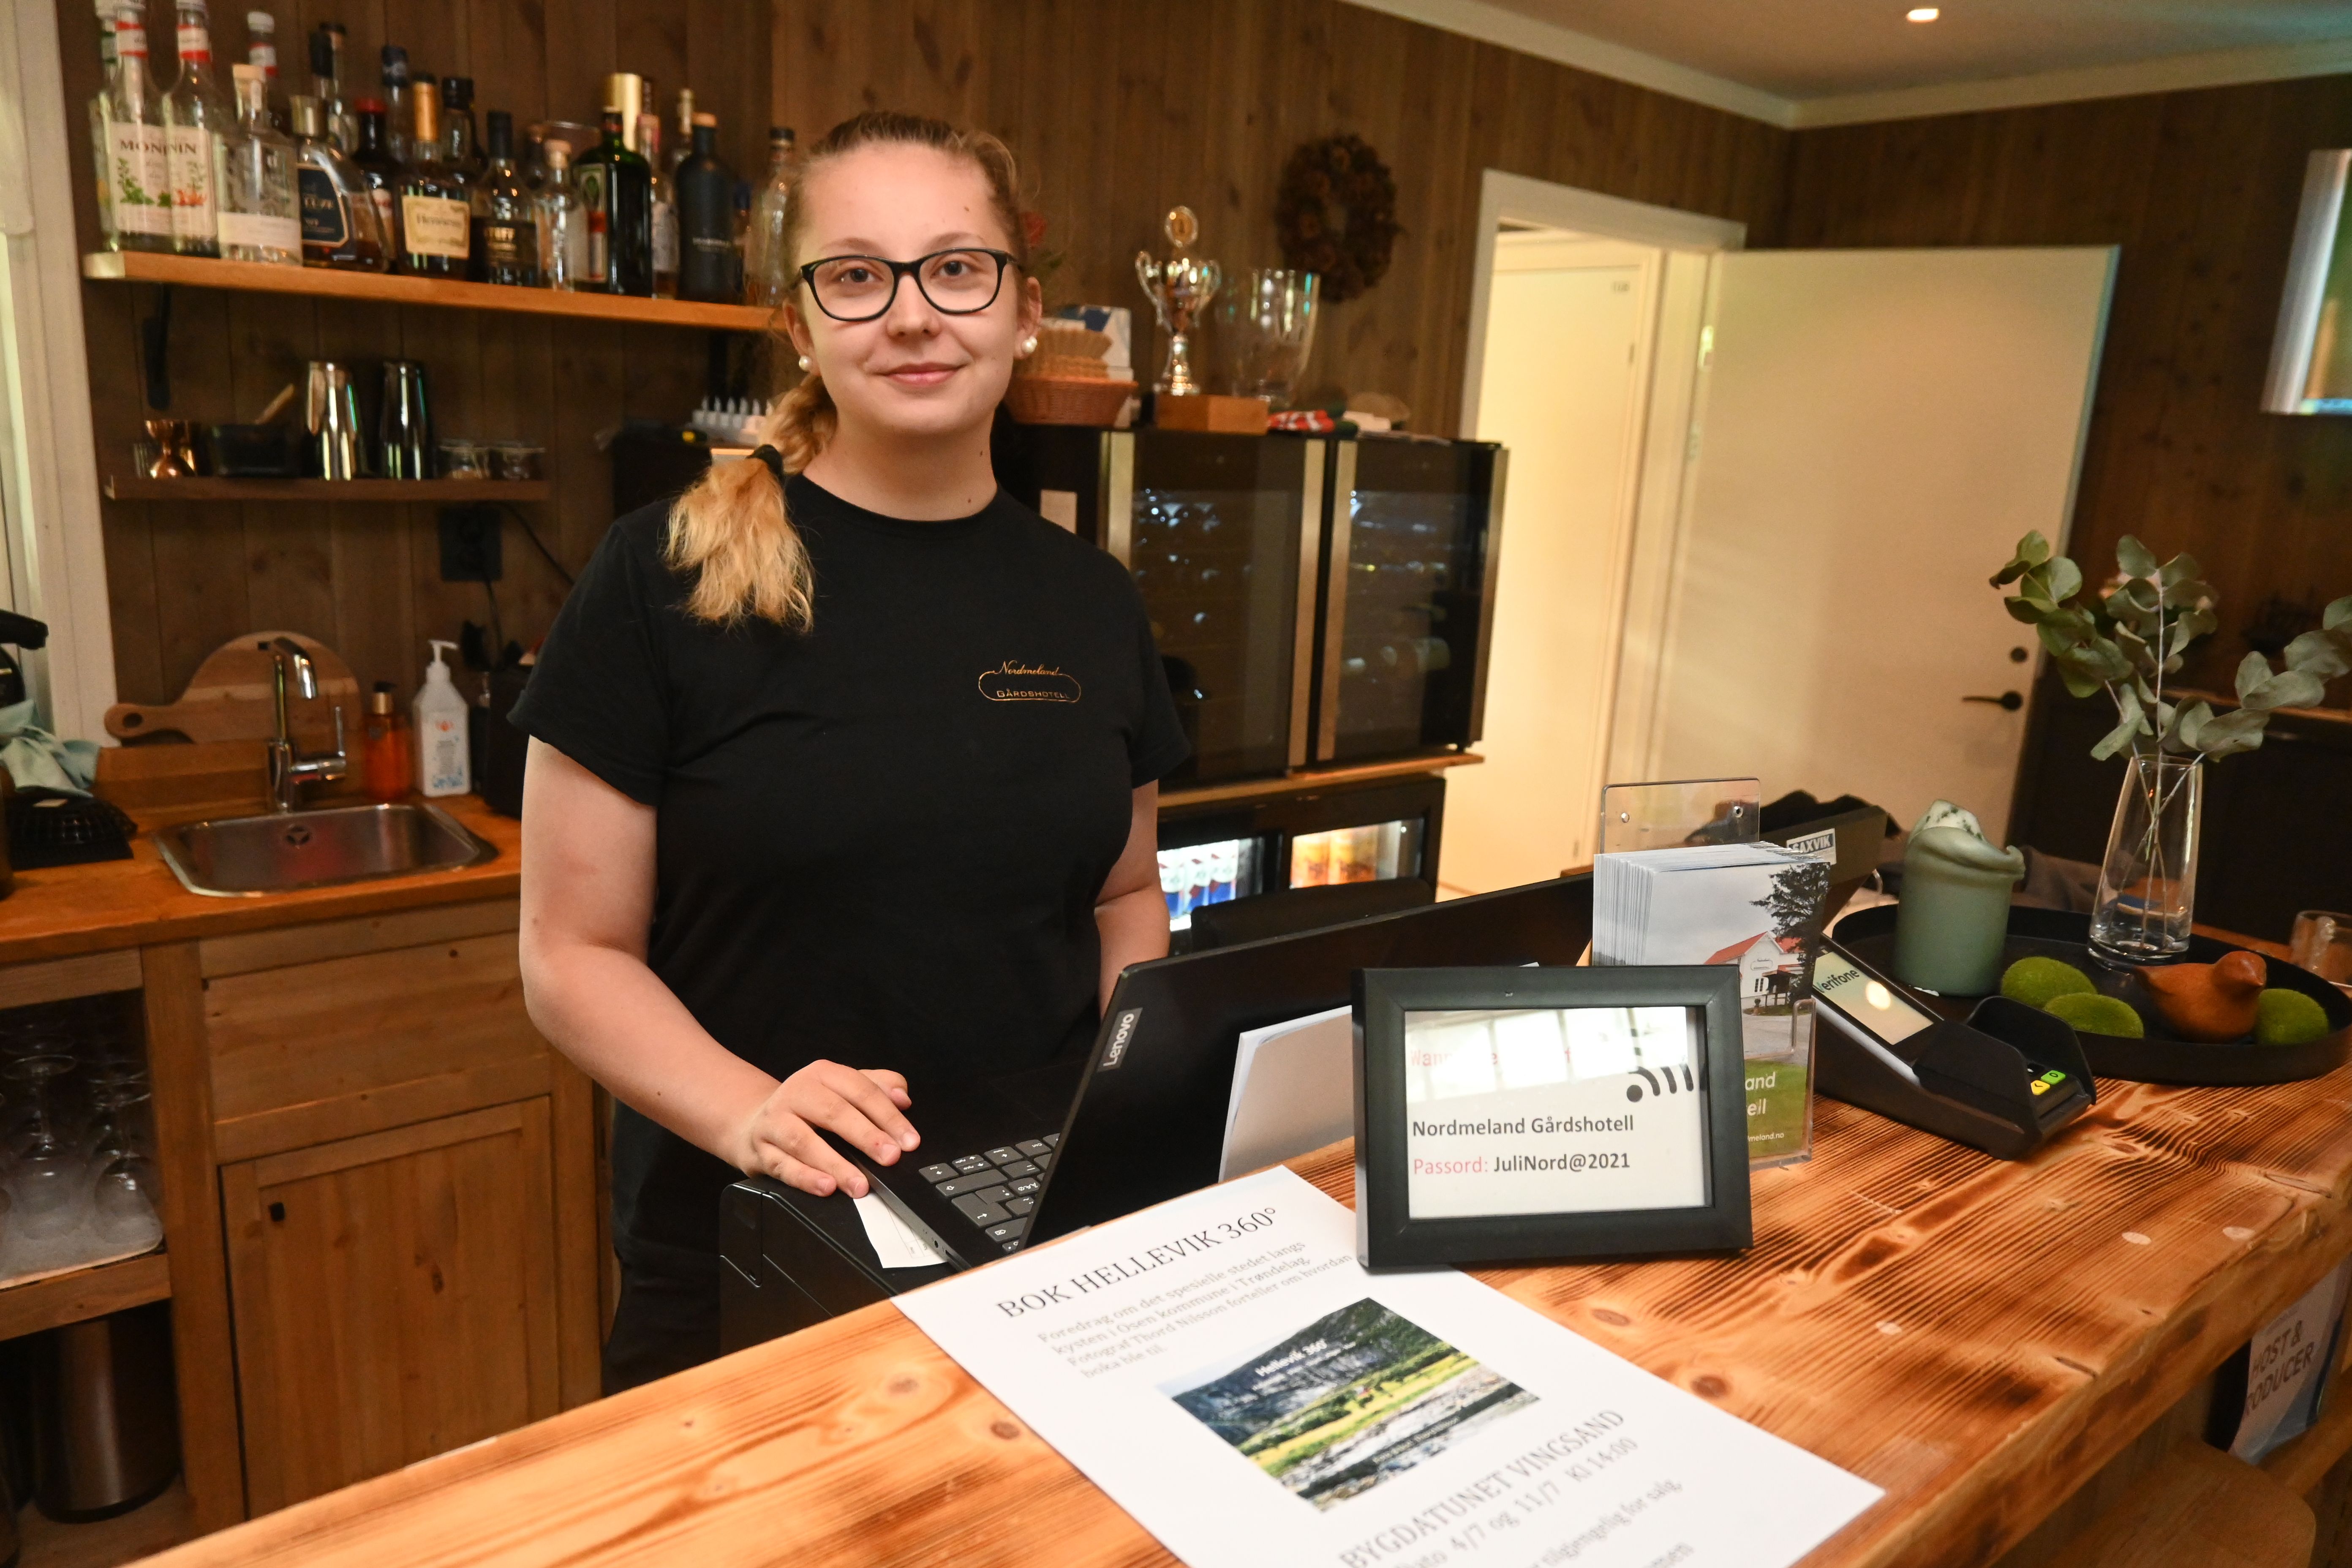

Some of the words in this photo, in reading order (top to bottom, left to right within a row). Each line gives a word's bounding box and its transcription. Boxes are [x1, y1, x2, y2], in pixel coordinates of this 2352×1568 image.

[996, 660, 1059, 675] Nordmeland
[996, 688, 1070, 698] GÅRDSHOTELL
[1793, 835, 1831, 853] SAXVIK
[1813, 970, 1859, 993] Verifone
[1102, 1013, 1135, 1067] Lenovo
[1413, 1118, 1525, 1136] Nordmeland
[1531, 1115, 1634, 1133] Gårdshotell
[1414, 1156, 1488, 1175] Passord:
[1494, 1153, 1631, 1172] JuliNord@2021
[996, 1285, 1073, 1318] BOK
[1070, 1230, 1222, 1293] HELLEVIK
[1217, 1207, 1276, 1239] 360°
[1038, 1315, 1114, 1342] Foredrag
[1113, 1306, 1138, 1318] om
[1140, 1295, 1166, 1309] det
[1166, 1272, 1226, 1298] spesielle
[1228, 1254, 1270, 1275] stedet
[1266, 1242, 1306, 1259] langs
[1067, 1339, 1131, 1366] Fotograf
[1130, 1323, 1177, 1344] Thord
[1175, 1304, 1228, 1327] Nilsson
[1226, 1283, 1279, 1308] forteller
[1281, 1274, 1302, 1286] om
[1299, 1255, 1352, 1278] hvordan
[1051, 1333, 1108, 1355] kysten
[1107, 1328, 1117, 1337] i
[1116, 1315, 1158, 1333] Osen
[1155, 1287, 1230, 1318] kommune
[1080, 1361, 1122, 1378] boka
[1119, 1353, 1146, 1364] ble
[1254, 1349, 1306, 1377] Hellevik
[2250, 1328, 2291, 1384] HOST
[2290, 1320, 2303, 1347] &
[1338, 1470, 1512, 1568] BYGDATUNET
[1505, 1410, 1624, 1477] VINGSAND
[1450, 1522, 1487, 1550] 4/7
[1488, 1511, 1520, 1530] og
[1514, 1479, 1561, 1513] 11/7
[1587, 1437, 1638, 1469] 14:00
